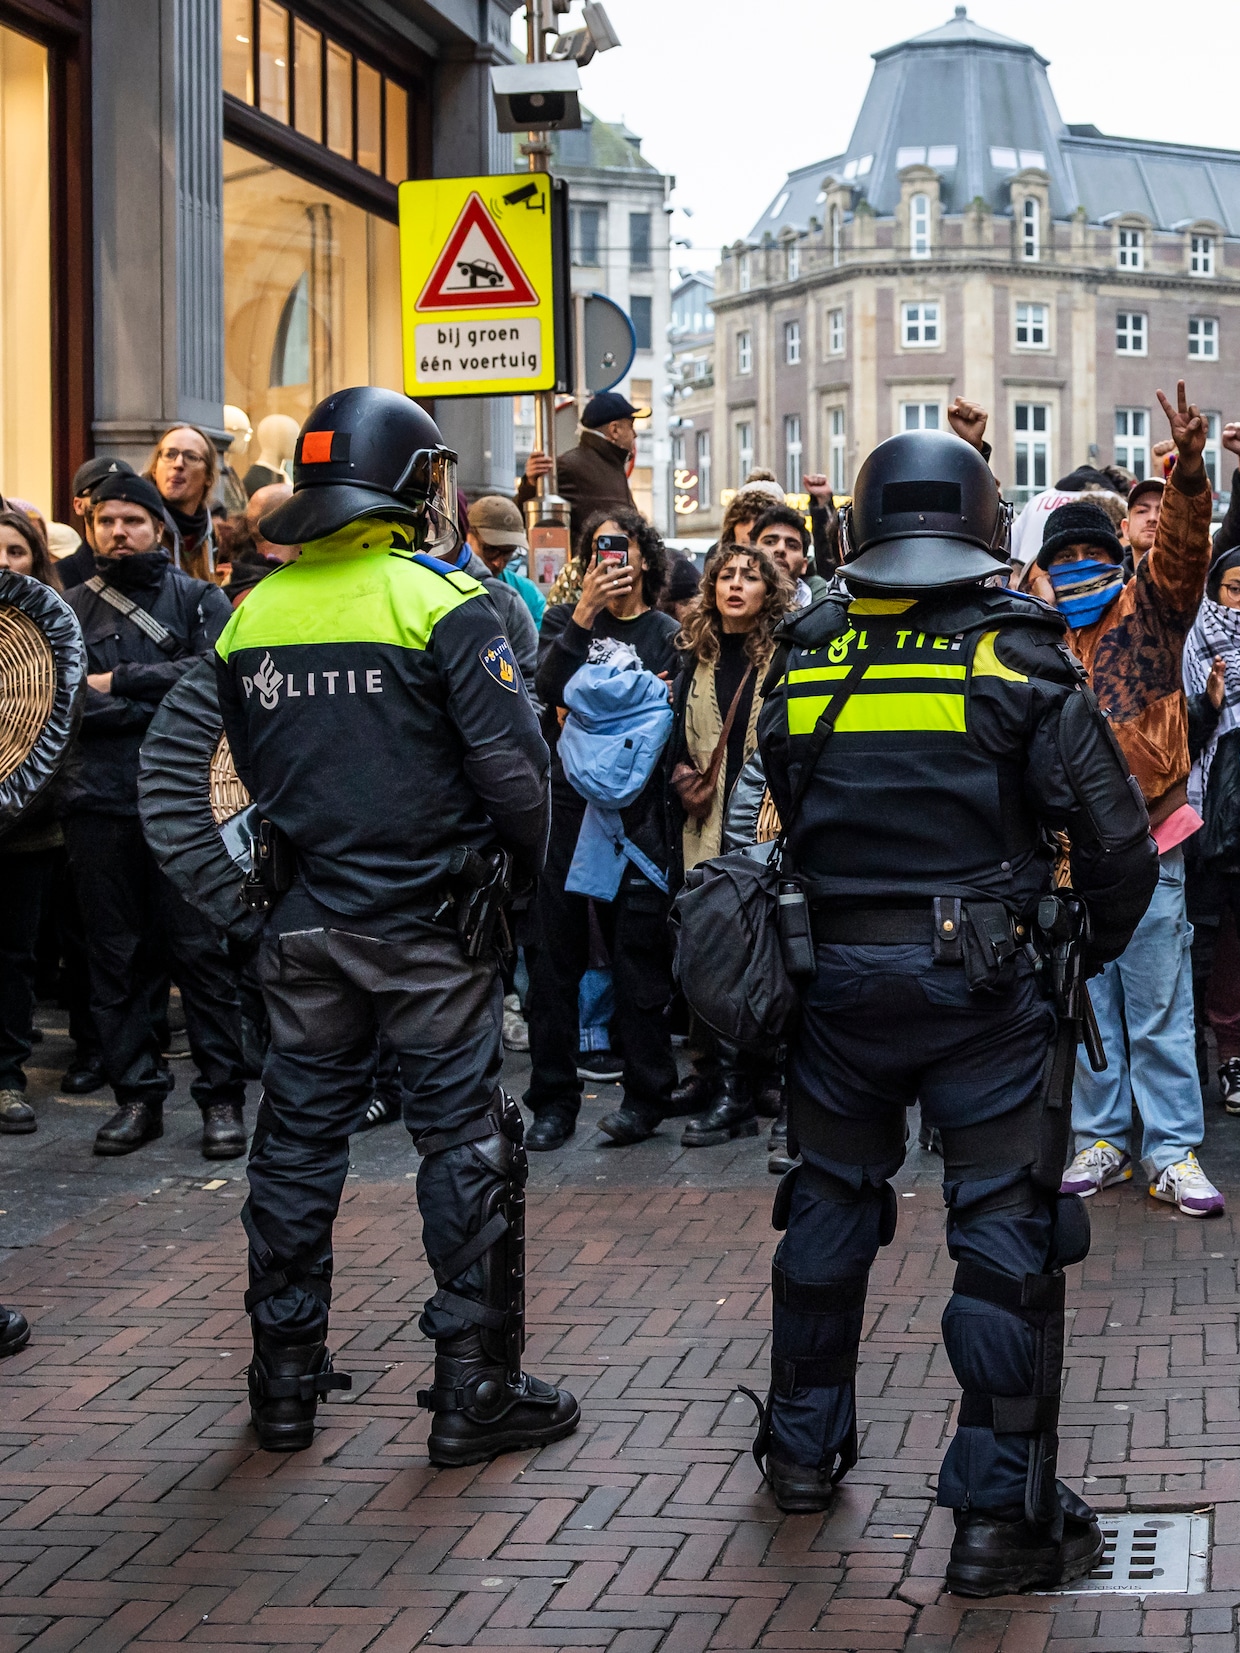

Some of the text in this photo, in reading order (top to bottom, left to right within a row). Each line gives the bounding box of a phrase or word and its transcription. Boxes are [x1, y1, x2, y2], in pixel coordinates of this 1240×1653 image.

[438, 328, 519, 348] bij groen
[420, 352, 537, 372] één voertuig
[241, 668, 384, 710] POLITIE
